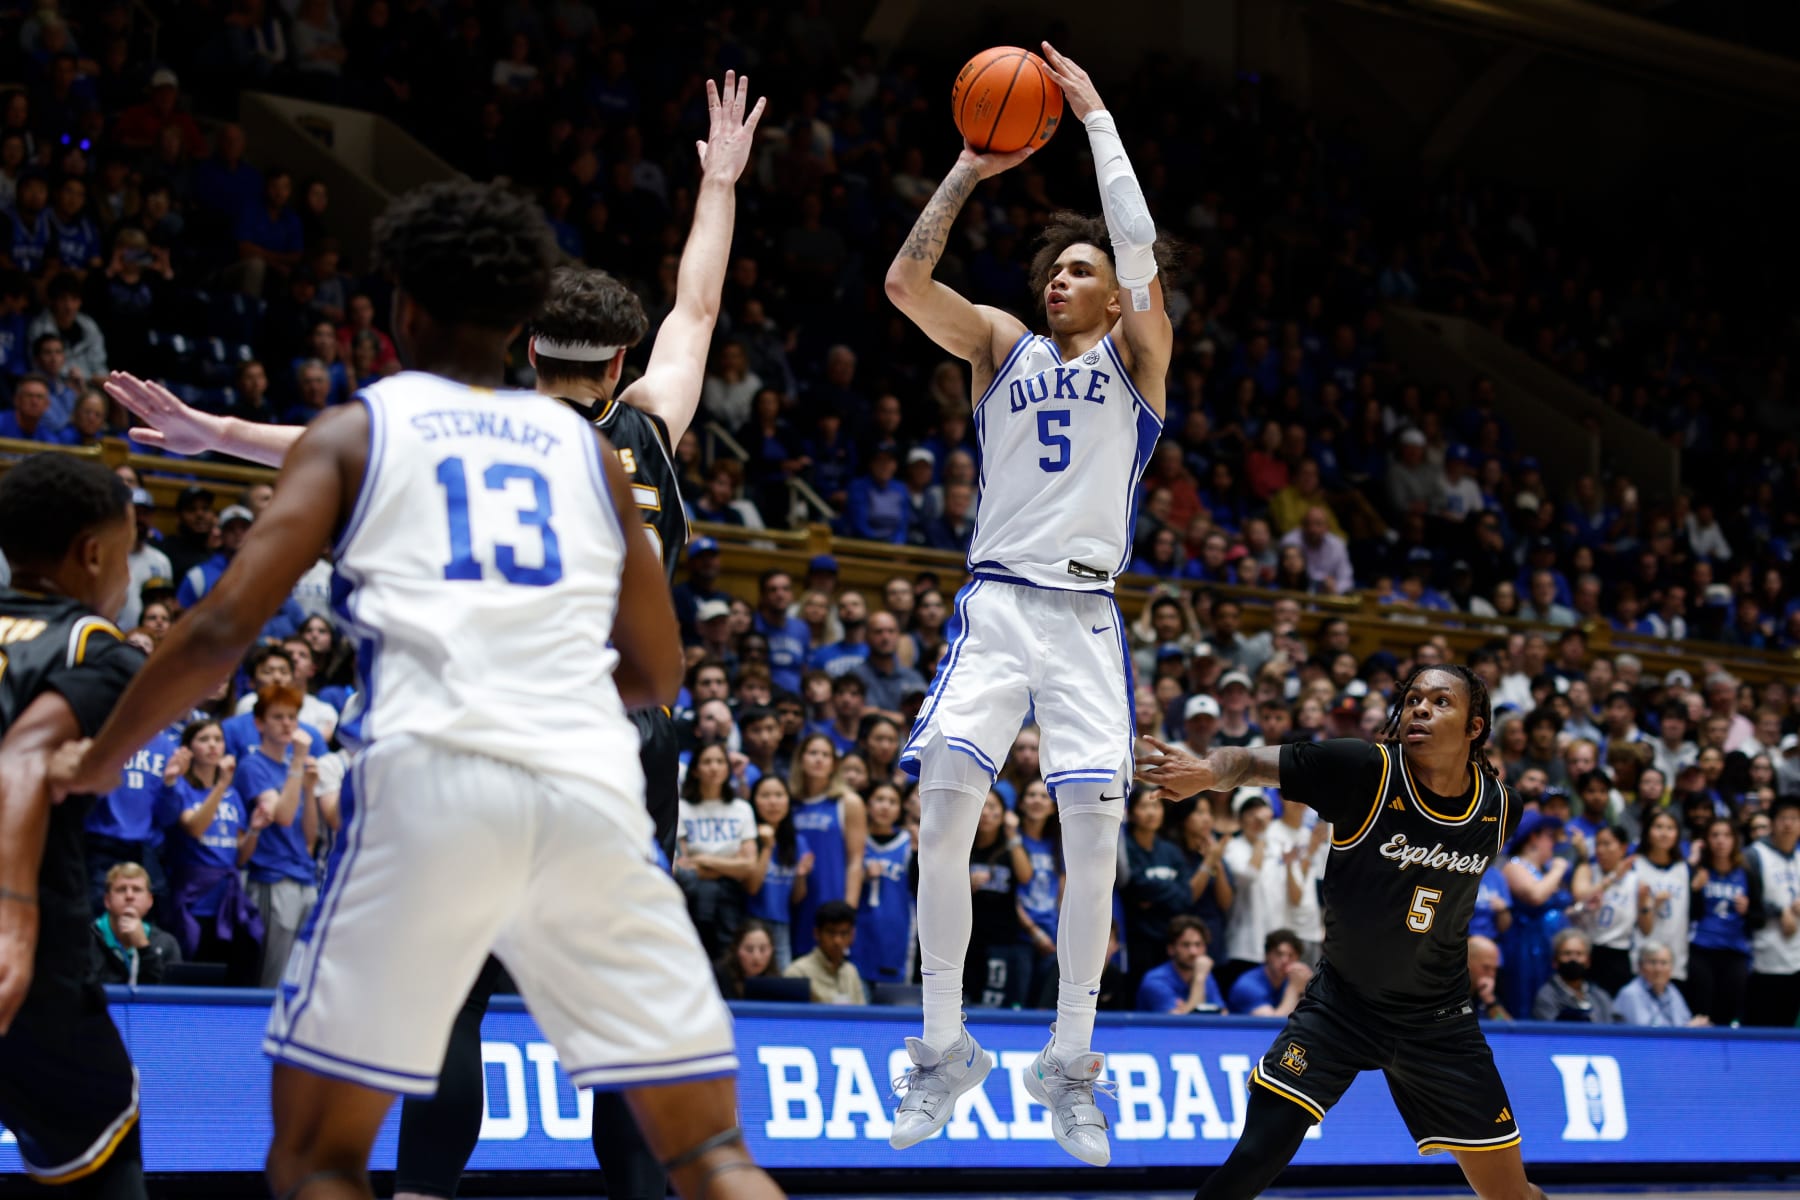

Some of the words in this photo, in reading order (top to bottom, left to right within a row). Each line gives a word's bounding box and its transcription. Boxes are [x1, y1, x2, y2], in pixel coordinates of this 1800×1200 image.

[1010, 368, 1110, 413] DUKE
[411, 409, 561, 456] STEWART
[1037, 410, 1071, 472] 5
[436, 457, 565, 587] 13
[683, 817, 741, 843] DUKE
[1379, 833, 1490, 875] Explorers
[1405, 885, 1443, 934] 5
[478, 1042, 594, 1140] DU
[758, 1046, 1321, 1140] BAKEBAL
